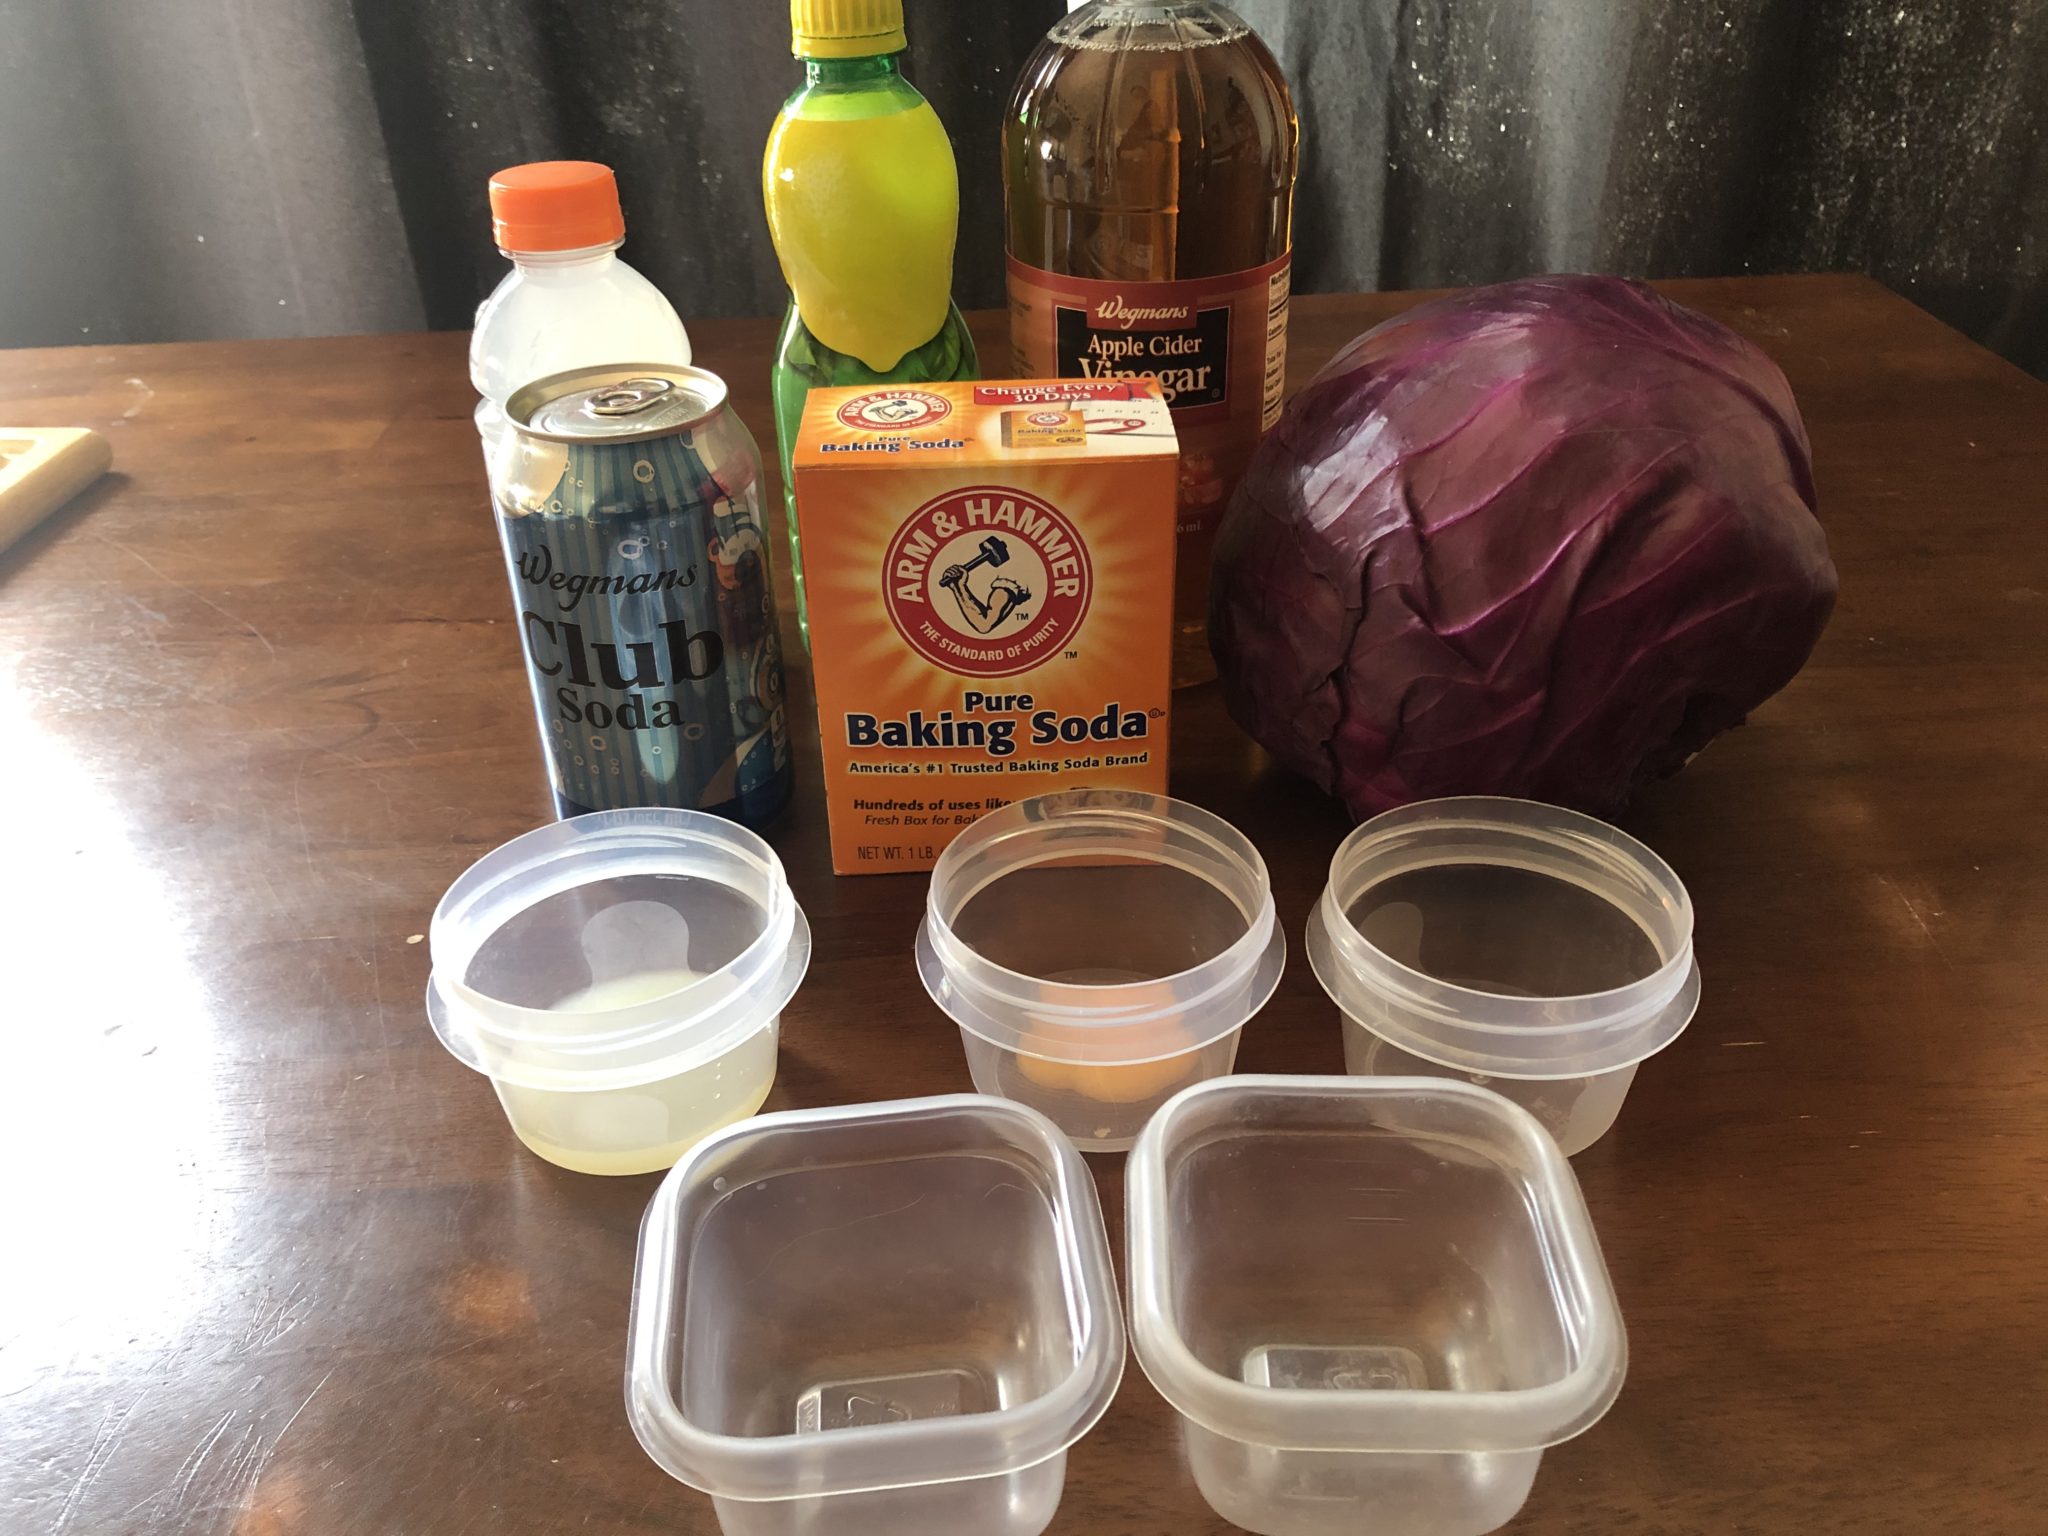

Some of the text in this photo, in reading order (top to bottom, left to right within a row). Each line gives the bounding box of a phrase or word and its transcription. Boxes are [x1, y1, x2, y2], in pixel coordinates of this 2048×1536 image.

[1095, 295, 1189, 330] Wegmans
[1087, 334, 1203, 361] Apple Cider
[981, 383, 1117, 396] Change Every
[1014, 391, 1092, 402] 30 Days
[843, 391, 946, 417] ARM & HAMMER
[820, 438, 965, 453] Baking Soda
[895, 498, 1080, 603] ARM & HAMMER
[515, 545, 698, 613] Wegmans
[1015, 613, 1029, 621] TM
[521, 610, 724, 690] Club
[919, 617, 1060, 662] THE STANDARD OF PURITY
[1064, 651, 1078, 660] TM
[557, 687, 685, 731] Soda
[963, 691, 1035, 713] Pure
[845, 702, 1149, 756] Baking Soda
[849, 752, 1149, 774] America's #1 Trusted Baking Soda Brand
[853, 799, 924, 811] Hundreds
[927, 798, 944, 810] of
[948, 800, 981, 811] uses
[864, 813, 983, 826] Fresh Box for Bak
[857, 846, 880, 860] NET
[882, 846, 905, 860] WT.
[908, 846, 914, 860] 1
[918, 846, 936, 860] LB.
